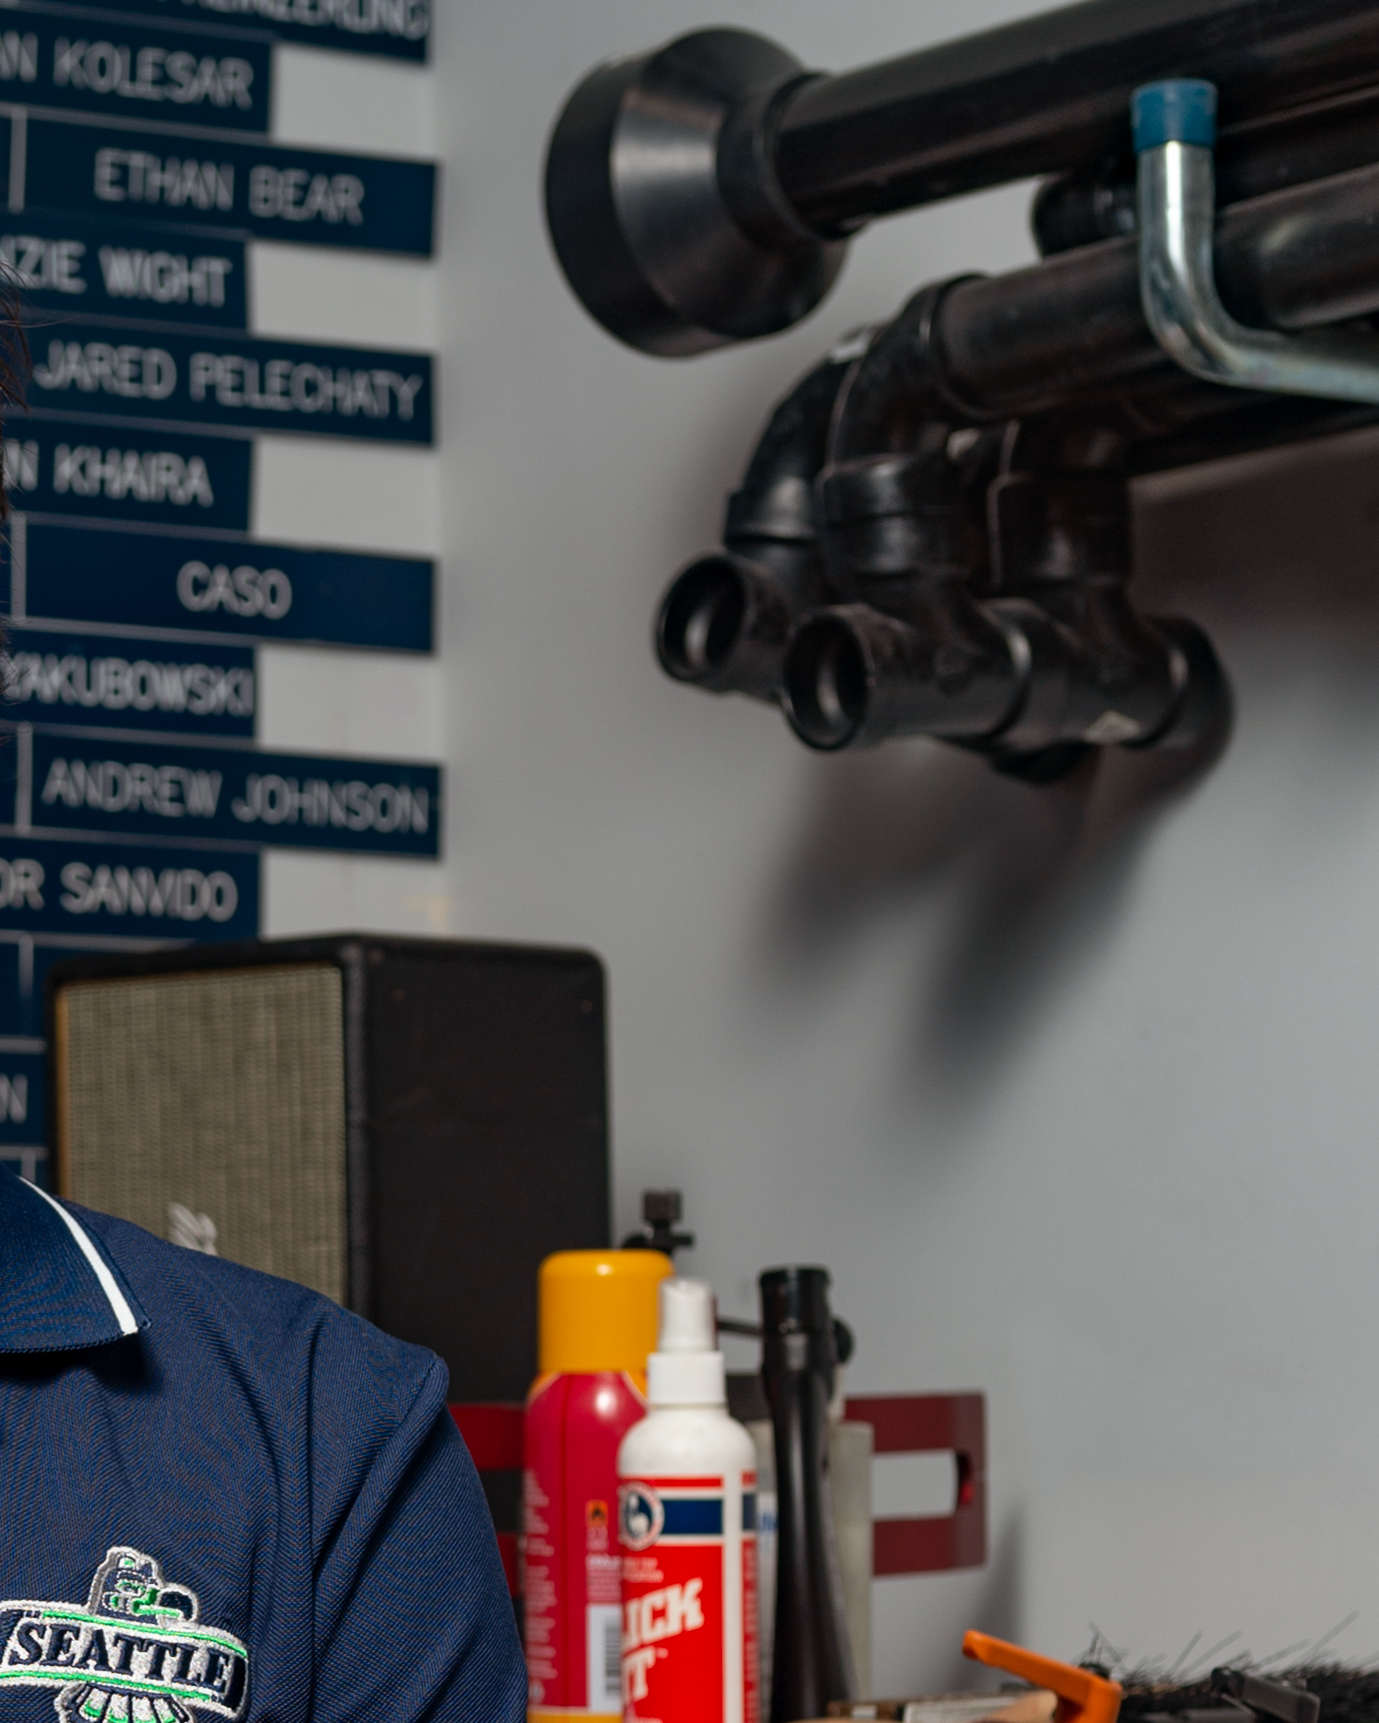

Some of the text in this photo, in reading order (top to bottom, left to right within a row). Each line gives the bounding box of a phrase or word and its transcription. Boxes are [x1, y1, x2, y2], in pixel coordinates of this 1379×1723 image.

[53, 37, 254, 110] KOLESAR
[93, 147, 365, 225] ETHAN BEAR
[33, 339, 423, 420] JARED PELECHATY
[53, 444, 214, 506] KHAIRA
[177, 561, 292, 619] CASO
[41, 758, 221, 818] ANDREW
[233, 774, 430, 834] JOHNSON
[59, 861, 238, 922] SANVIDO
[8, 1620, 232, 1694] SEATTLE
